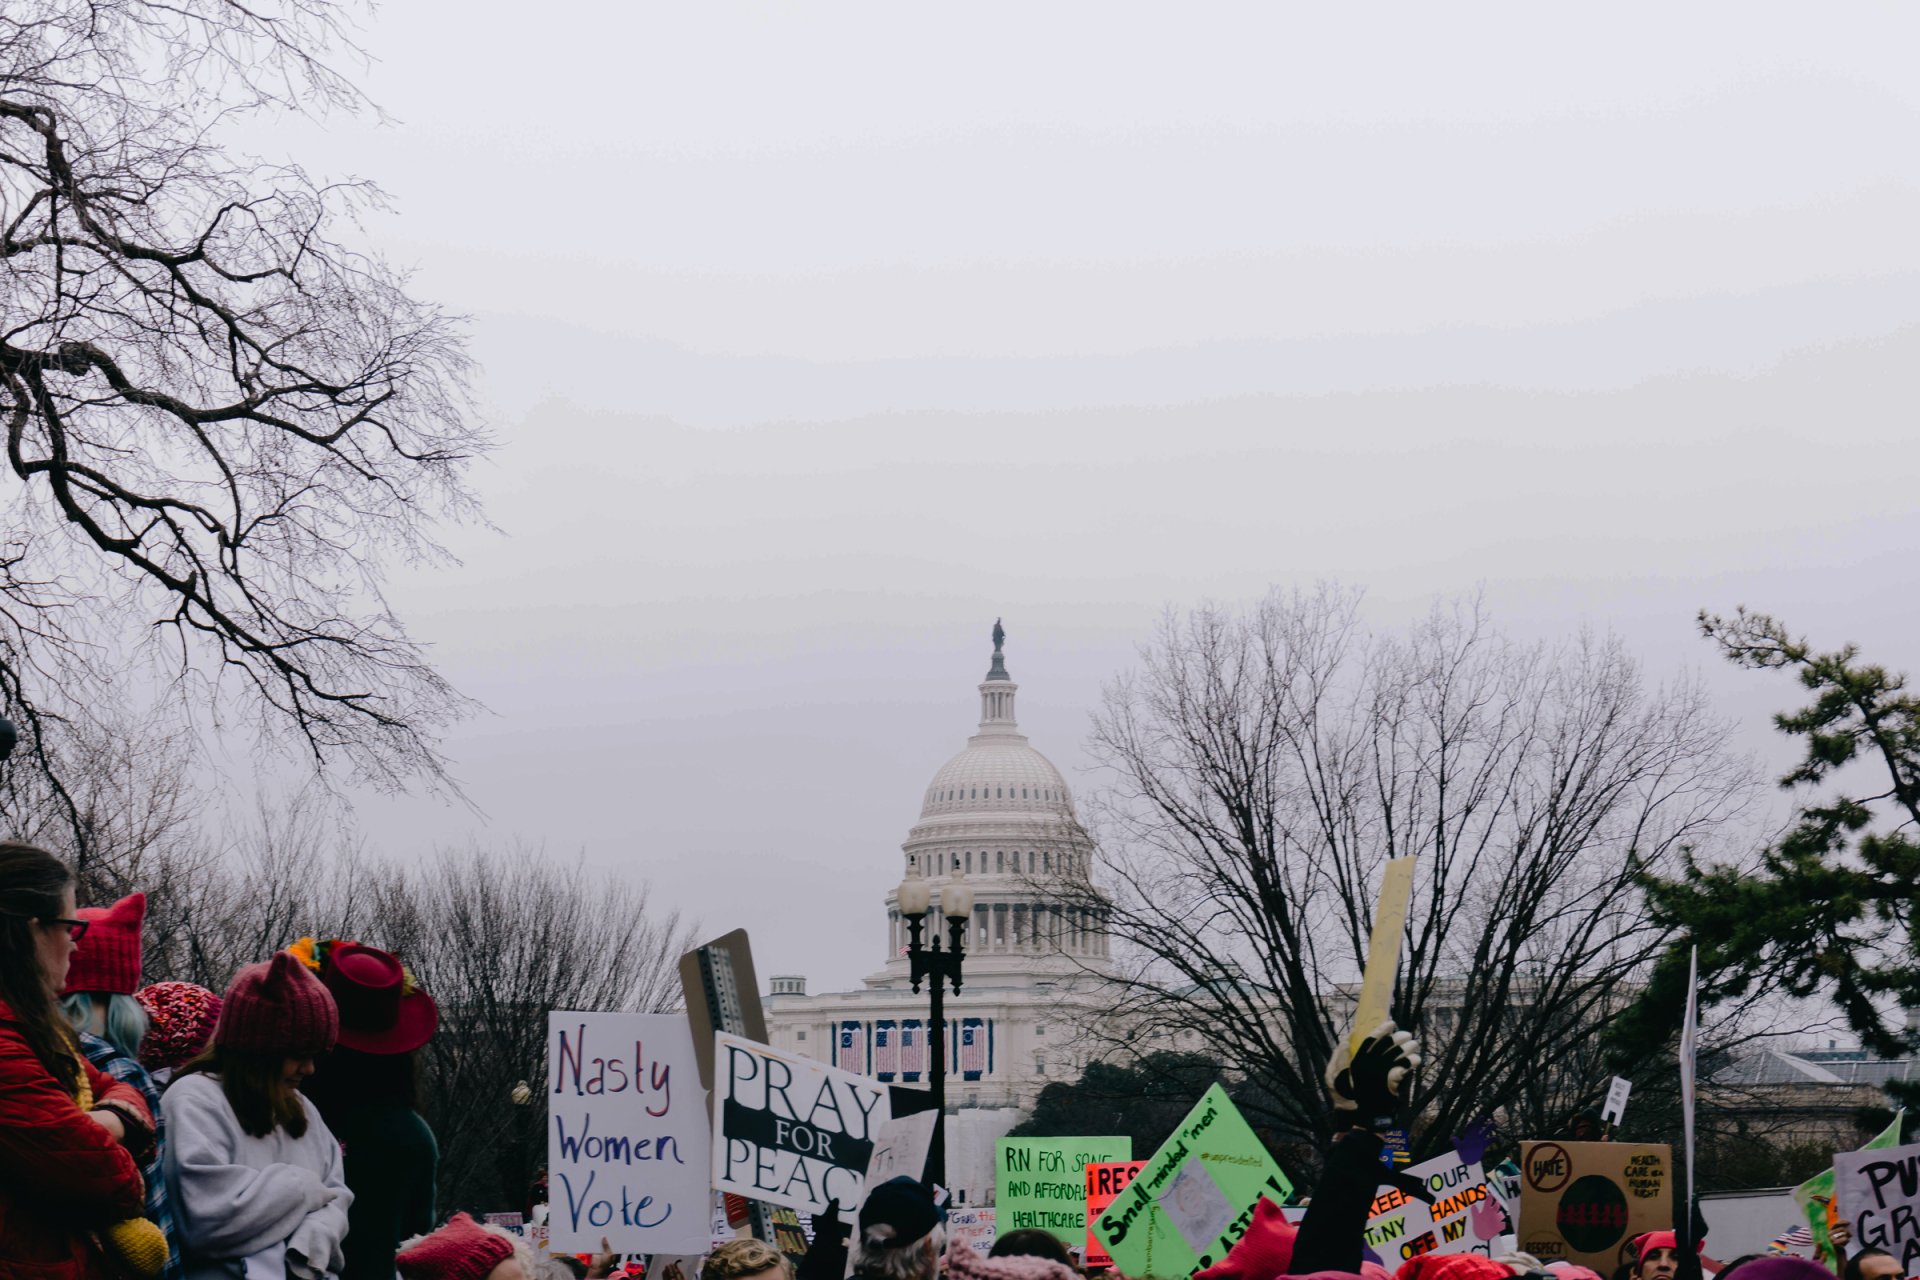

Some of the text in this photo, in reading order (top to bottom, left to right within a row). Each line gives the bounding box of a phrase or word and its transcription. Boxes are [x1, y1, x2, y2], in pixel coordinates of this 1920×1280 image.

[553, 1023, 671, 1117] Nasty
[723, 1043, 883, 1142] PRAY
[555, 1112, 685, 1165] Women
[775, 1119, 836, 1160] FOR
[1006, 1147, 1031, 1172] RN
[1039, 1151, 1065, 1174] FOR
[722, 1138, 860, 1213] PEAC
[1008, 1181, 1030, 1198] AND
[1534, 1159, 1565, 1176] HATE
[1857, 1156, 1920, 1209] PU
[557, 1170, 672, 1233] Vote
[1013, 1210, 1086, 1229] HEALTHCARE
[1429, 1183, 1488, 1222] HANDS
[1400, 1215, 1467, 1261] OFF MY
